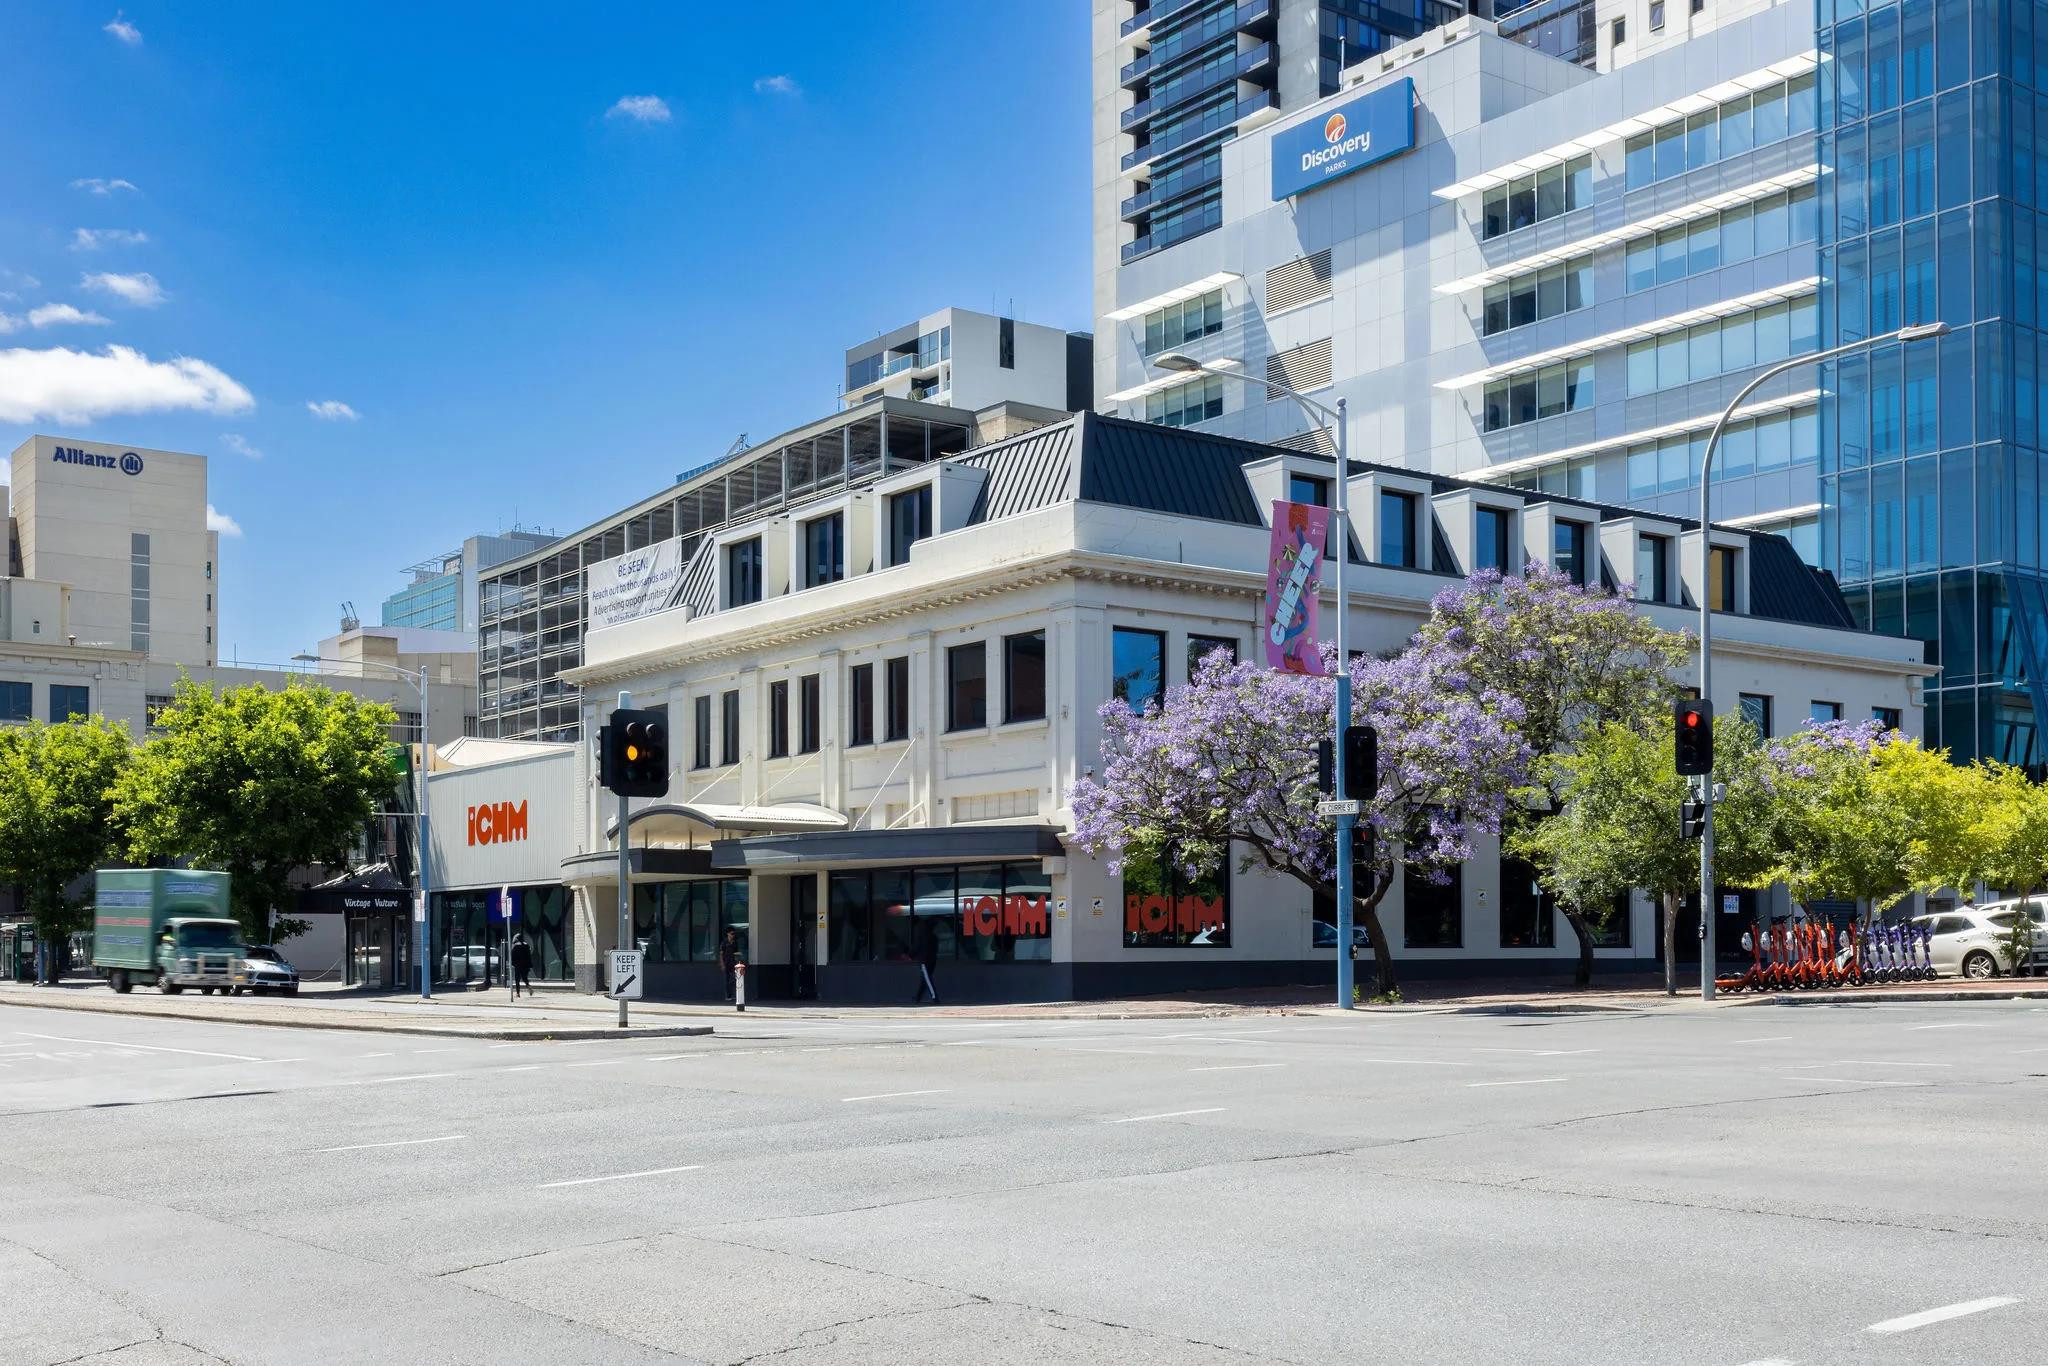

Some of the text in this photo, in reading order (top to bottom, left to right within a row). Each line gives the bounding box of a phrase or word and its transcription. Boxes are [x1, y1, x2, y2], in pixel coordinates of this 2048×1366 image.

[1301, 131, 1370, 172] Discovery
[1325, 159, 1347, 175] PARKS
[53, 446, 116, 469] Allianz
[618, 564, 627, 577] BE
[592, 587, 609, 600] Reach
[609, 584, 619, 596] out
[619, 581, 627, 593] to
[1270, 542, 1319, 646] CHEER
[593, 599, 625, 615] Advertising
[626, 588, 667, 607] opportunities
[1328, 803, 1354, 812] CURRIE ST
[344, 898, 398, 908] Vintage Vulture
[616, 955, 636, 963] KEEP
[616, 965, 636, 973] LEFT
